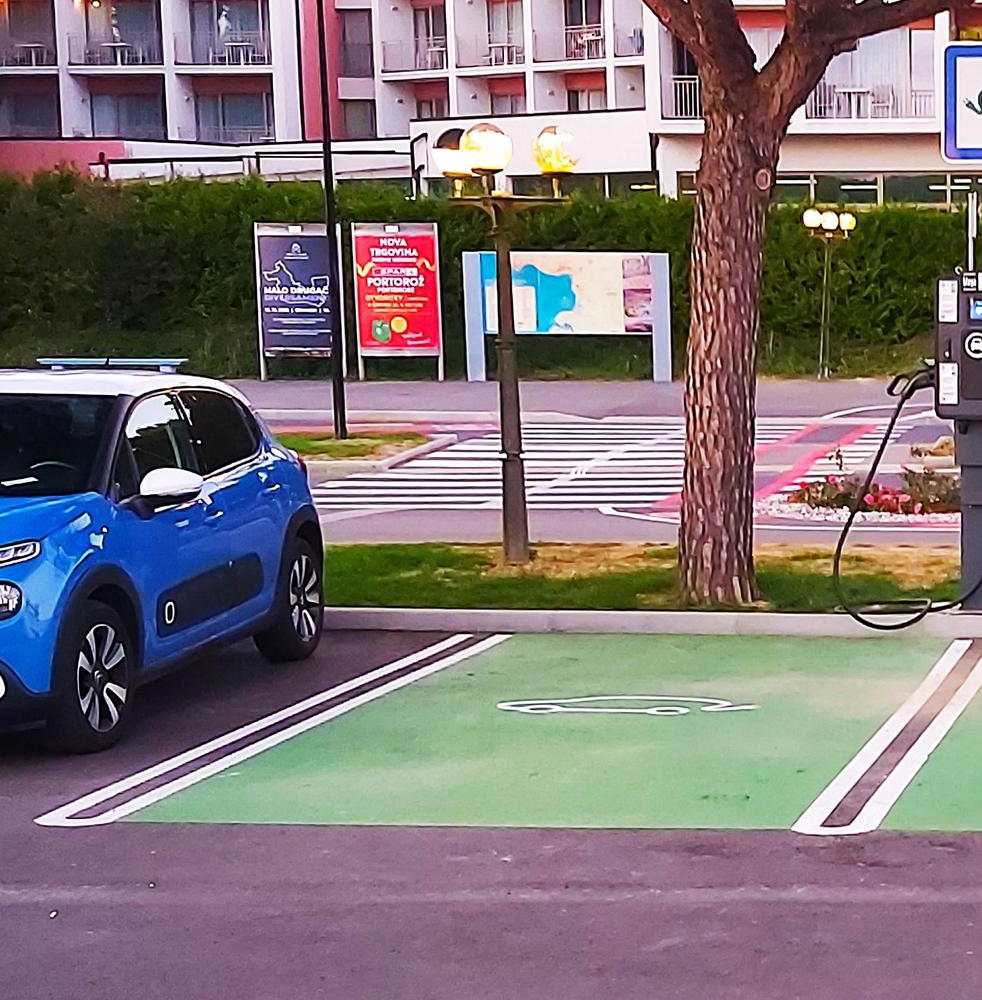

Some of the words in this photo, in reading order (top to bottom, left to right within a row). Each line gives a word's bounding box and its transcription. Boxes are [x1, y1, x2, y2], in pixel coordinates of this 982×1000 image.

[380, 238, 407, 246] NOVA
[370, 247, 418, 256] TRGOVINA
[367, 275, 424, 286] PORTOROŽ
[264, 286, 288, 294] MALO
